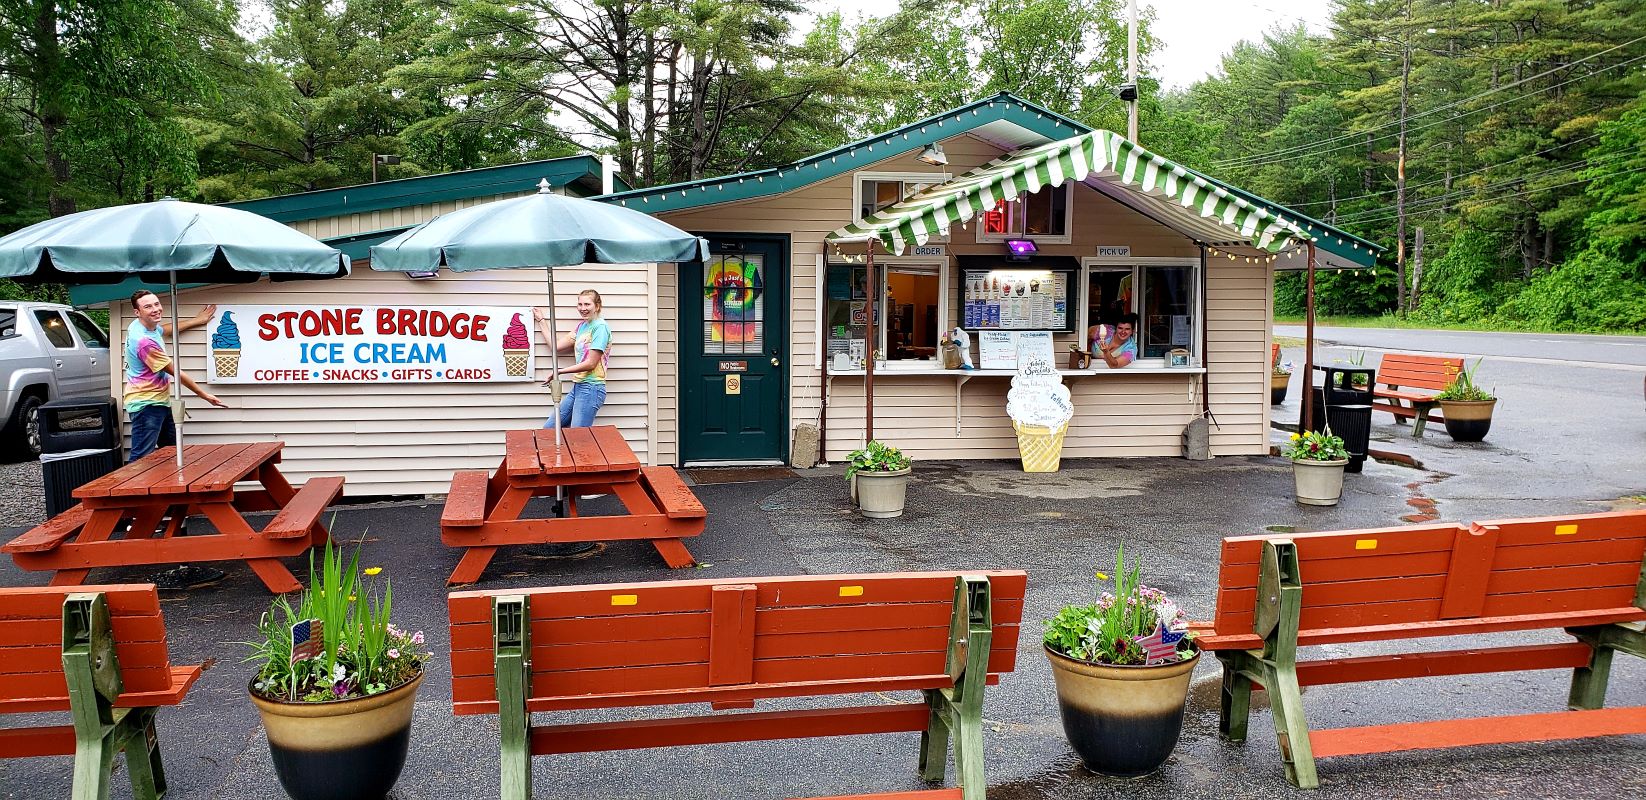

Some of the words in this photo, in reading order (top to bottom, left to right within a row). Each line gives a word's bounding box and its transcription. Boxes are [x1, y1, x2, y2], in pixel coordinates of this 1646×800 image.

[258, 309, 363, 341] STONE
[376, 308, 490, 342] BRIDGE
[300, 343, 344, 363] ICE
[354, 343, 447, 364] CREAM
[254, 370, 309, 381] COFFEE
[322, 370, 378, 381] SNACKS
[391, 369, 433, 380] GIFTS
[445, 368, 491, 380] CARDS
[721, 362, 730, 370] NO
